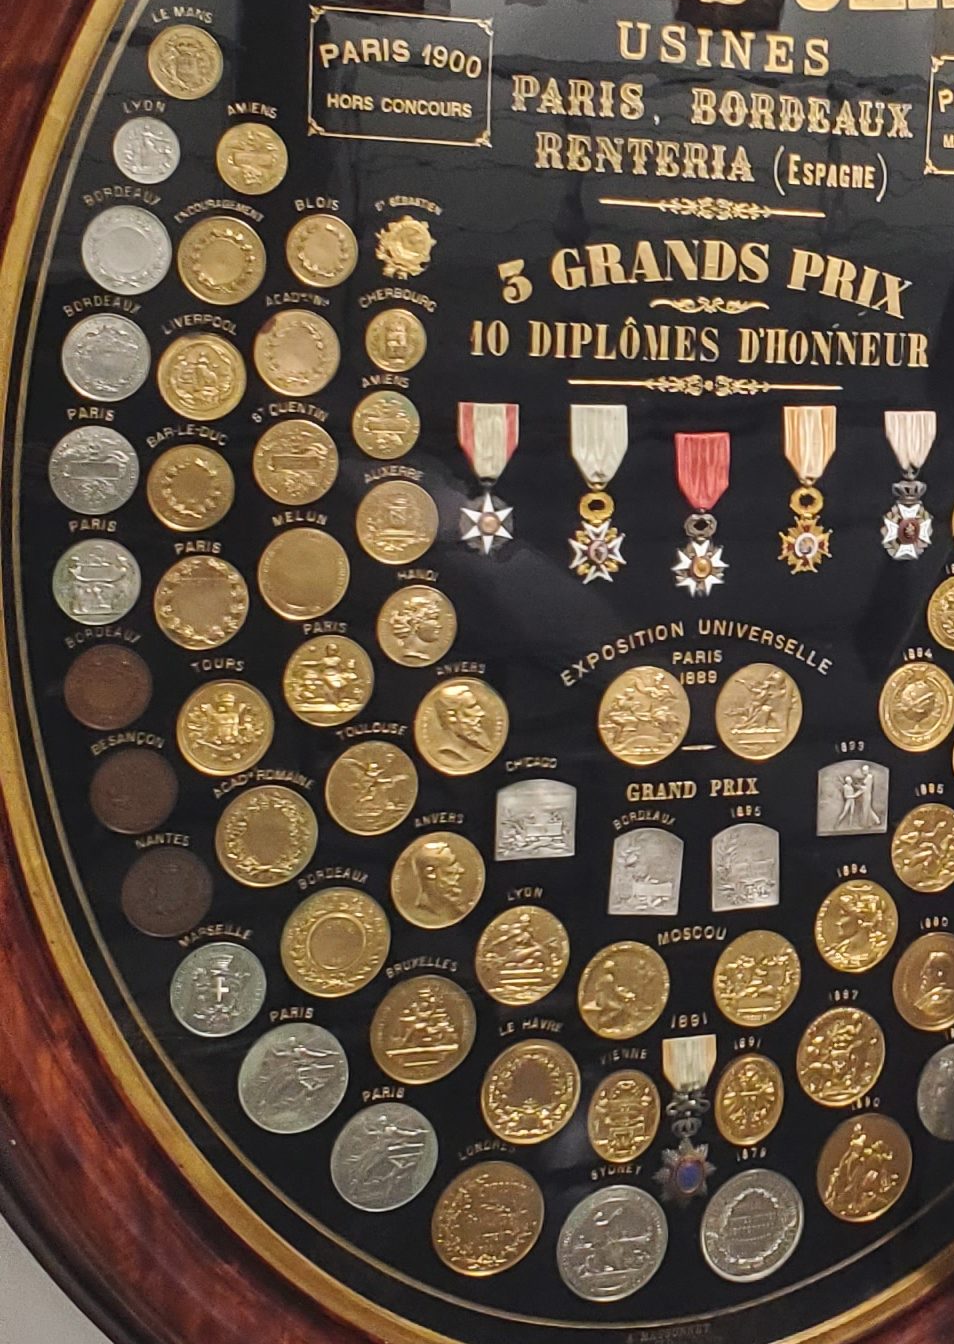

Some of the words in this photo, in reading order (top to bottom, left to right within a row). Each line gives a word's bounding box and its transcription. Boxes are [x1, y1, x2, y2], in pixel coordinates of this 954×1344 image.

[151, 8, 170, 24] LE
[173, 5, 214, 25] MANS
[617, 19, 831, 76] USINES
[319, 39, 411, 68] PARIS
[421, 42, 482, 79] 1900
[122, 99, 167, 115] LYON
[226, 102, 279, 120] AMIENS
[326, 92, 377, 114] HORS
[381, 96, 474, 120] CONCOURS
[691, 86, 914, 140] BORDEAUX
[535, 131, 755, 184] RENTERIA
[83, 185, 162, 207] BORDEAUX
[294, 197, 340, 212] BLOIS
[550, 239, 769, 290] GRANDS
[786, 248, 913, 320] PRIX
[62, 294, 142, 318] BORDEAUX
[357, 288, 438, 313] CHERBOURG
[161, 313, 238, 336] LIVERPOOL
[470, 320, 509, 356] 10
[528, 316, 720, 363] DIPLÔMES
[738, 327, 929, 368] D'HONNEUR
[361, 374, 411, 389] AMIENS
[67, 407, 116, 422] PARIS
[268, 401, 329, 422] QUENTIN
[146, 423, 231, 448] BAR-LE-DUC
[363, 465, 425, 483] AUXERRE
[68, 519, 117, 534] PARIS
[272, 510, 329, 527] MELUN
[174, 541, 222, 556] PARIS
[303, 621, 348, 635] PARIS
[64, 627, 142, 649] BORDEAUX
[561, 621, 684, 687] EXPOSITION
[698, 619, 833, 675] UNIVERSELLE
[672, 649, 723, 665] PARIS
[190, 658, 245, 673] TOURS
[436, 660, 486, 676] ANVERS
[680, 670, 718, 685] 1889
[335, 724, 408, 740] TOULOUSE
[90, 731, 165, 756] BESANÇON
[506, 757, 557, 772] CHICAGO
[626, 781, 697, 802] GRAND
[709, 778, 760, 797] PRIX
[413, 812, 464, 828] ANVERS
[612, 810, 676, 831] BORDEAUX
[135, 834, 191, 849] NANTES
[298, 867, 369, 890] BORDEAUX
[507, 886, 543, 901] LYON
[178, 924, 254, 947] MARSEILLE
[657, 925, 727, 945] MOSCOU
[385, 957, 458, 978] BRUXELLES
[269, 1007, 314, 1022] PARIS
[499, 1022, 515, 1036] LE
[362, 1087, 405, 1103] PARIS
[591, 1164, 642, 1182] SYDNEY
